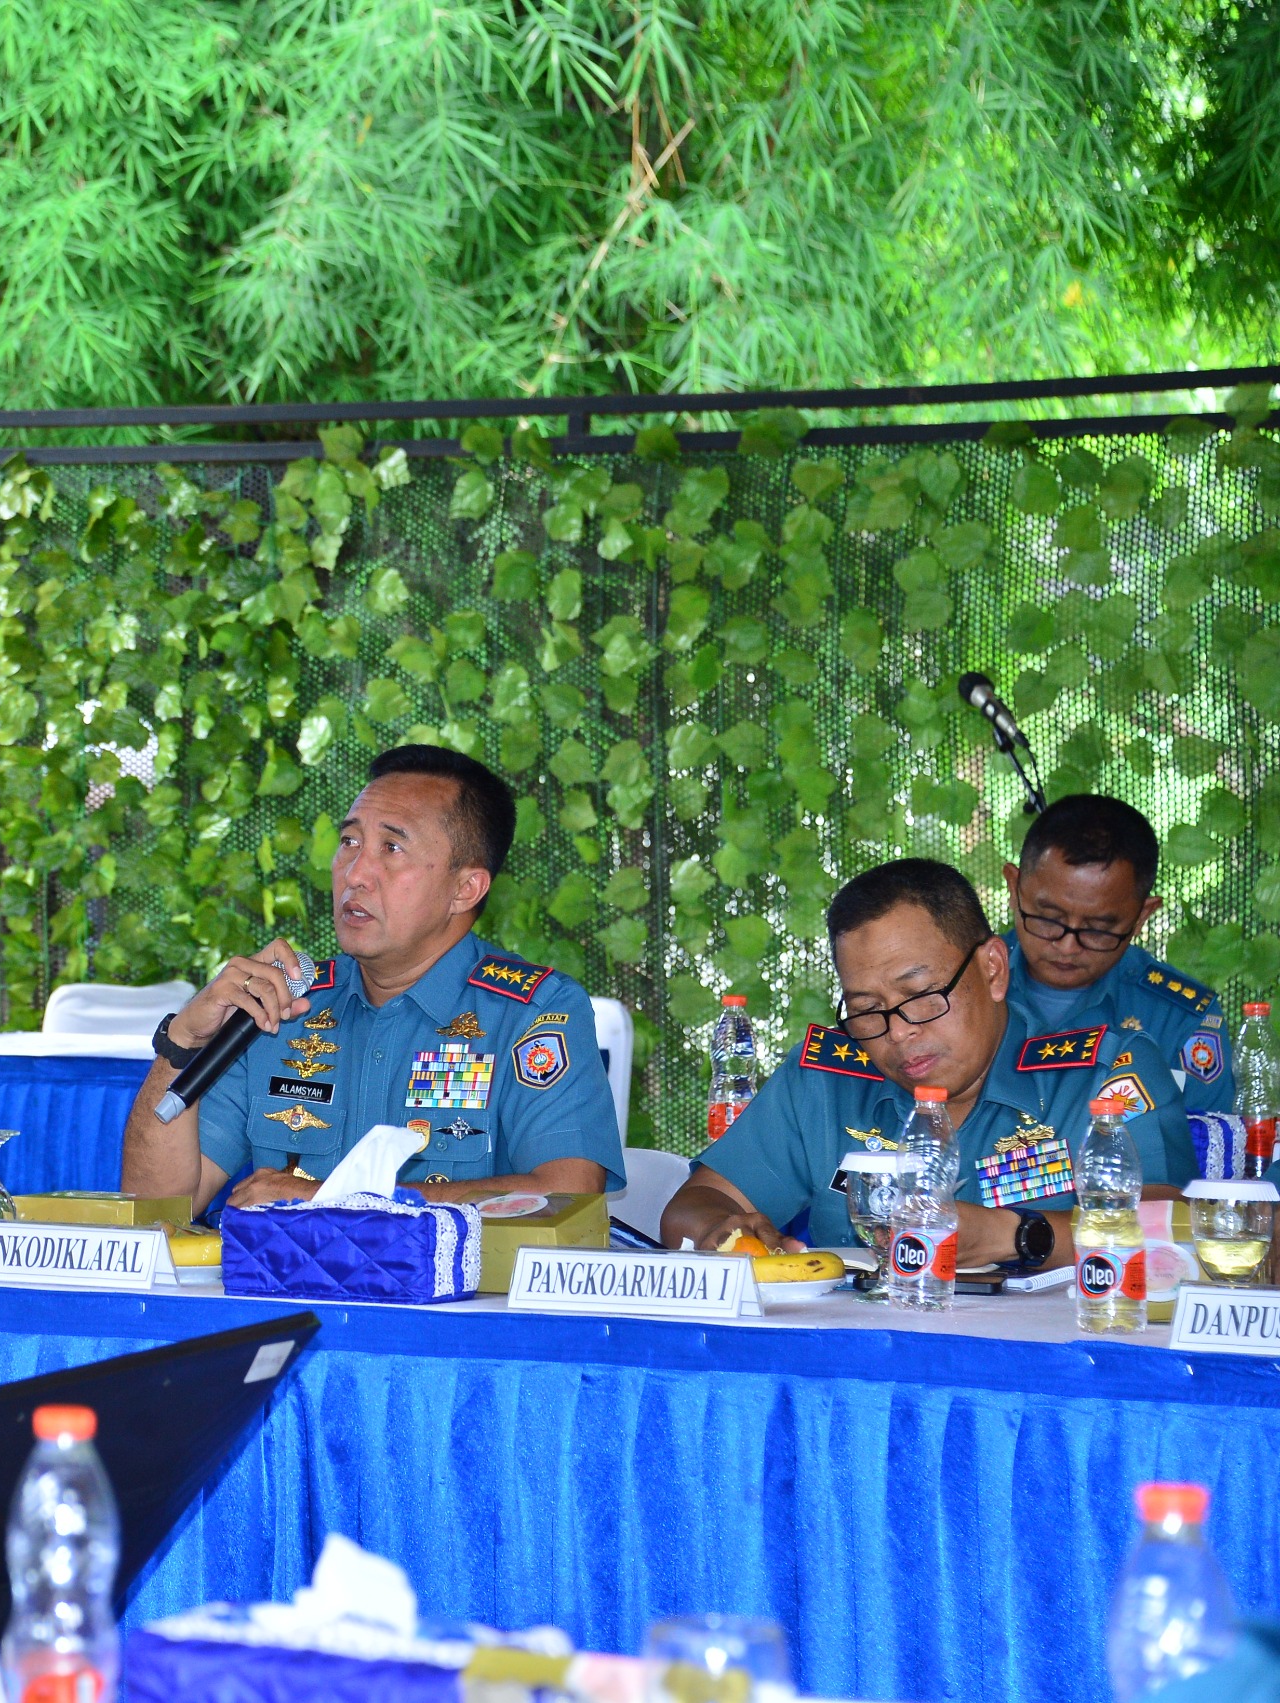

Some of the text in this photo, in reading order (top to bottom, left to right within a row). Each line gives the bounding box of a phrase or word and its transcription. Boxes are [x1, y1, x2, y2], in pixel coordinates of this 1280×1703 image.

[521, 970, 543, 992] TNI
[805, 1031, 825, 1061] TNI
[1081, 1031, 1100, 1060] TNI
[279, 1083, 323, 1098] ALAMSYAH
[897, 1243, 926, 1266] Cleo
[526, 1260, 731, 1301] PANGKOARMADA I
[1083, 1265, 1115, 1286] Cleo
